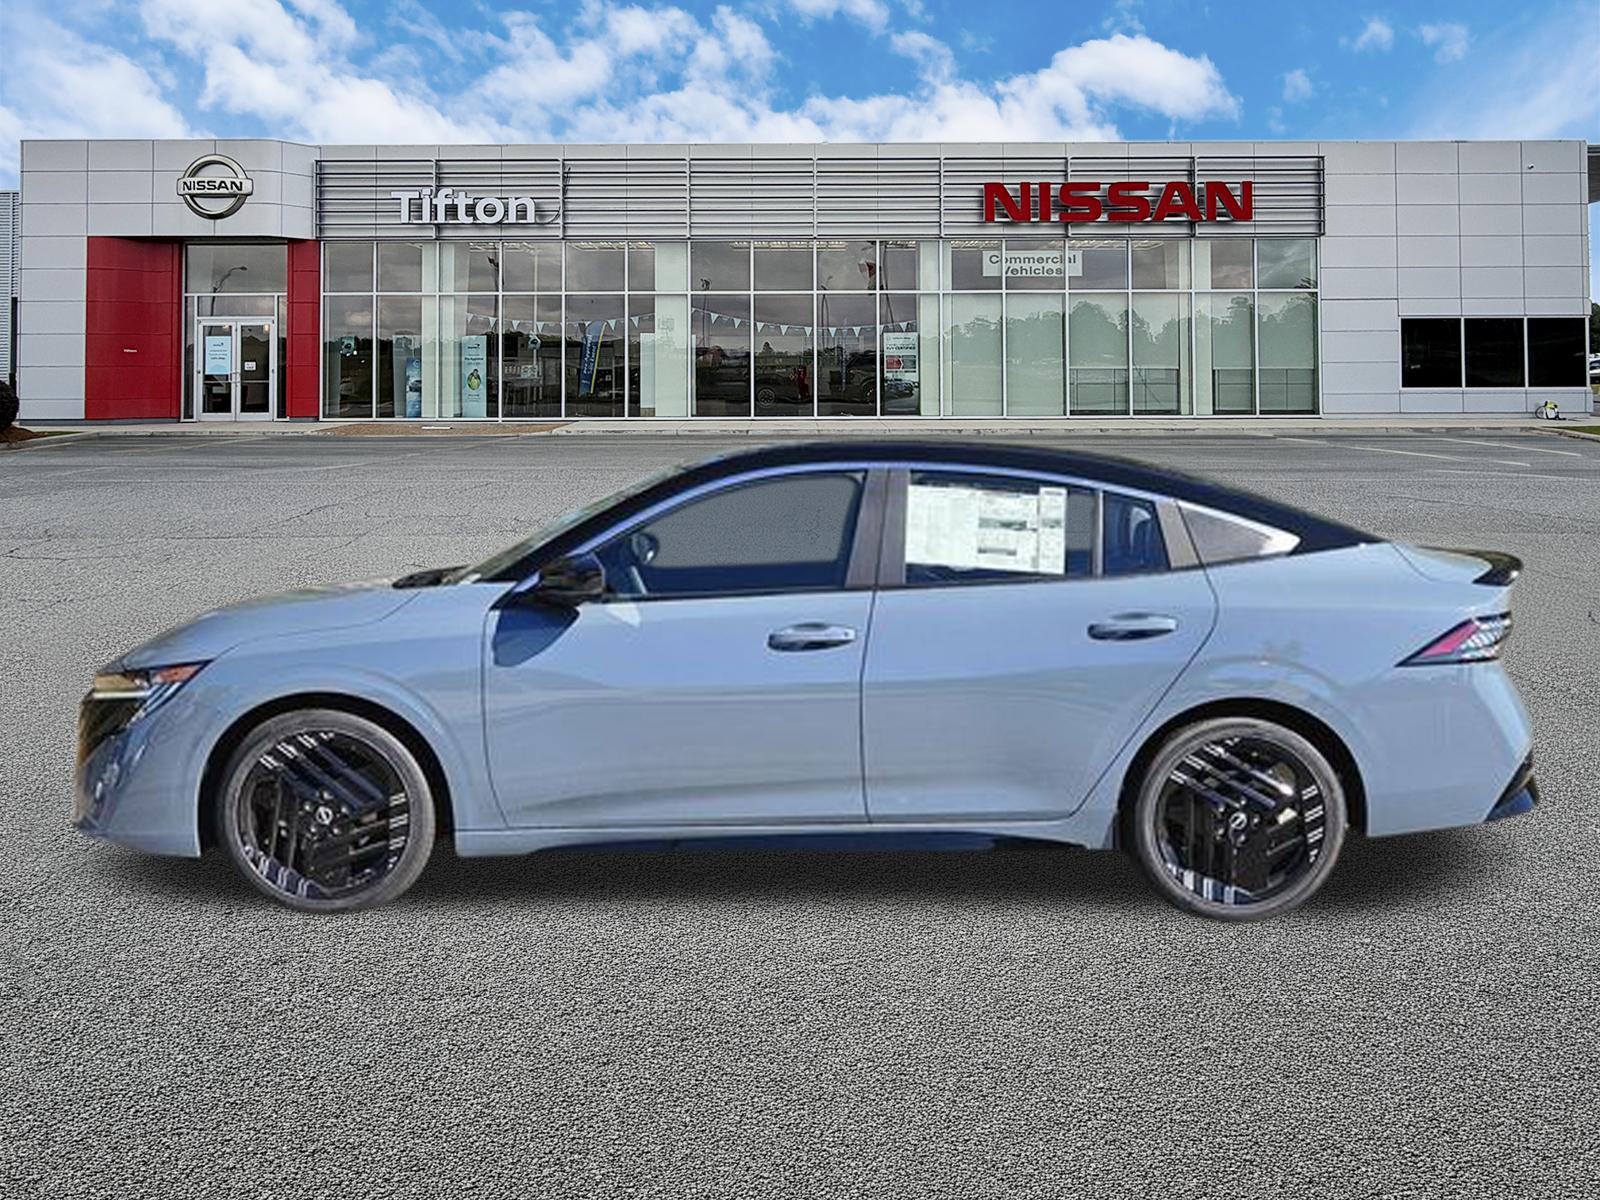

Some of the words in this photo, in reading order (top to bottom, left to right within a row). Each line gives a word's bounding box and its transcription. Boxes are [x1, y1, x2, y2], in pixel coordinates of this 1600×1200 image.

[182, 180, 243, 191] NISSAN
[983, 180, 1253, 222] NISSAN
[391, 188, 536, 224] Tifton
